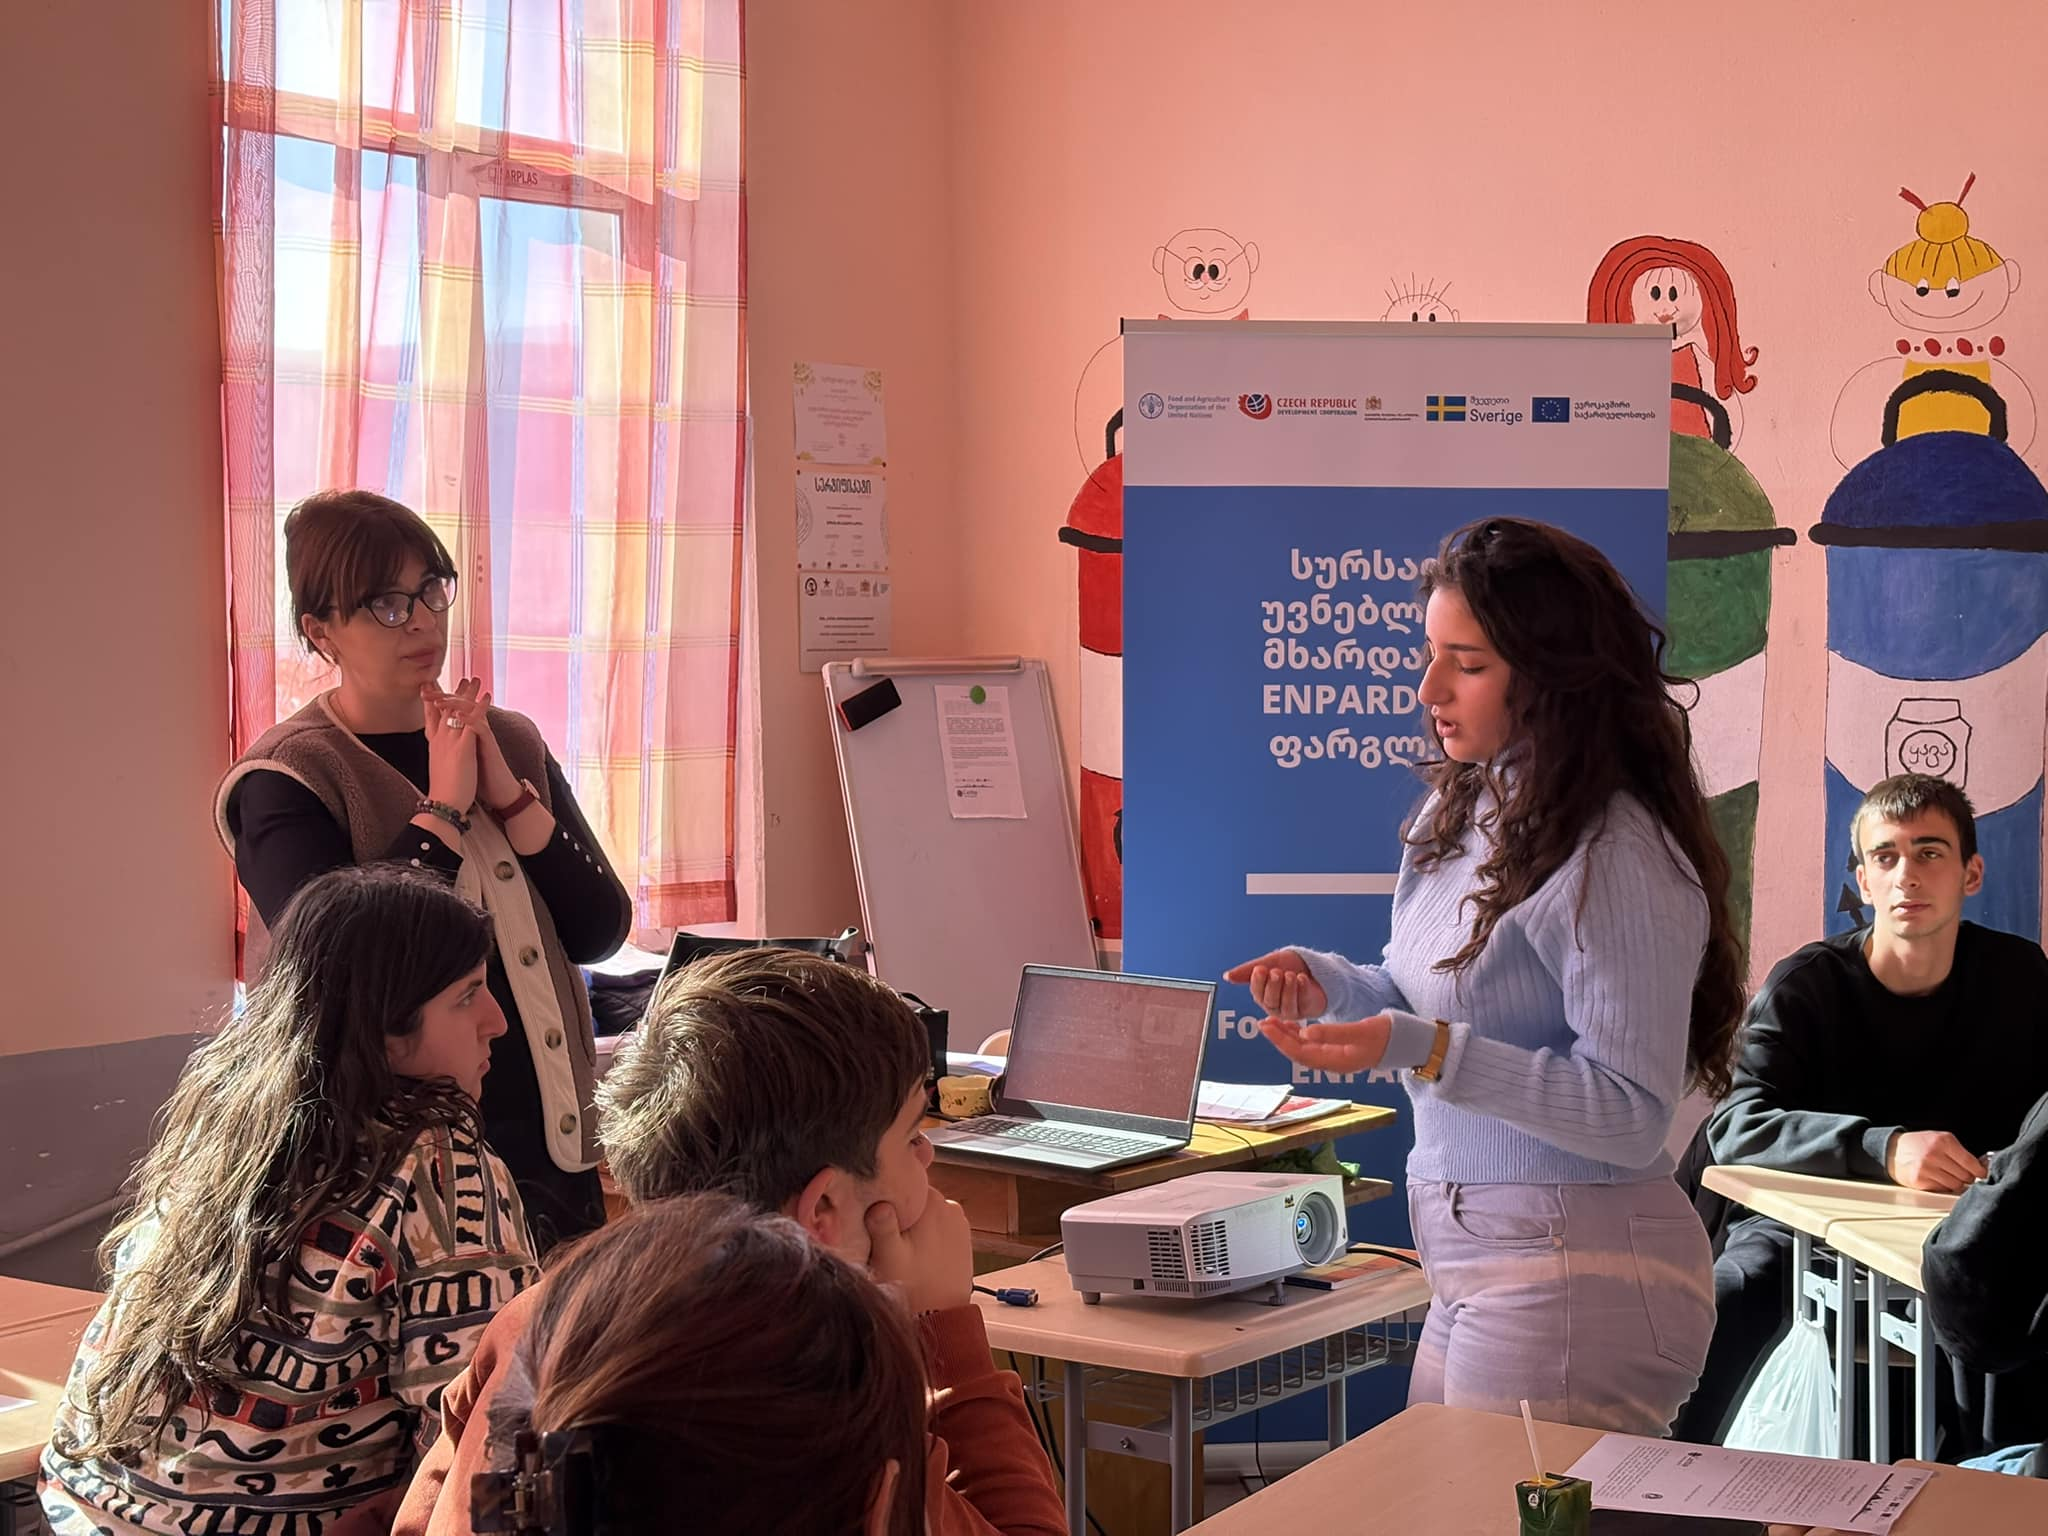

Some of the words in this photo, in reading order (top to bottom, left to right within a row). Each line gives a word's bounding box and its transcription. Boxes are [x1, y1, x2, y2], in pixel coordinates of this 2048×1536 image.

[1277, 398, 1306, 408] CZECH
[1310, 398, 1357, 409] REPUBLIC
[1574, 401, 1630, 410] ევროკავშირი
[1574, 410, 1656, 420] საქართველოსთვის
[1470, 408, 1523, 426] Sverige
[1261, 593, 1425, 634] უვნებლ
[1263, 637, 1423, 679] მხარდა
[1263, 684, 1417, 715] ENPARD
[1269, 727, 1432, 769] ფარგლ
